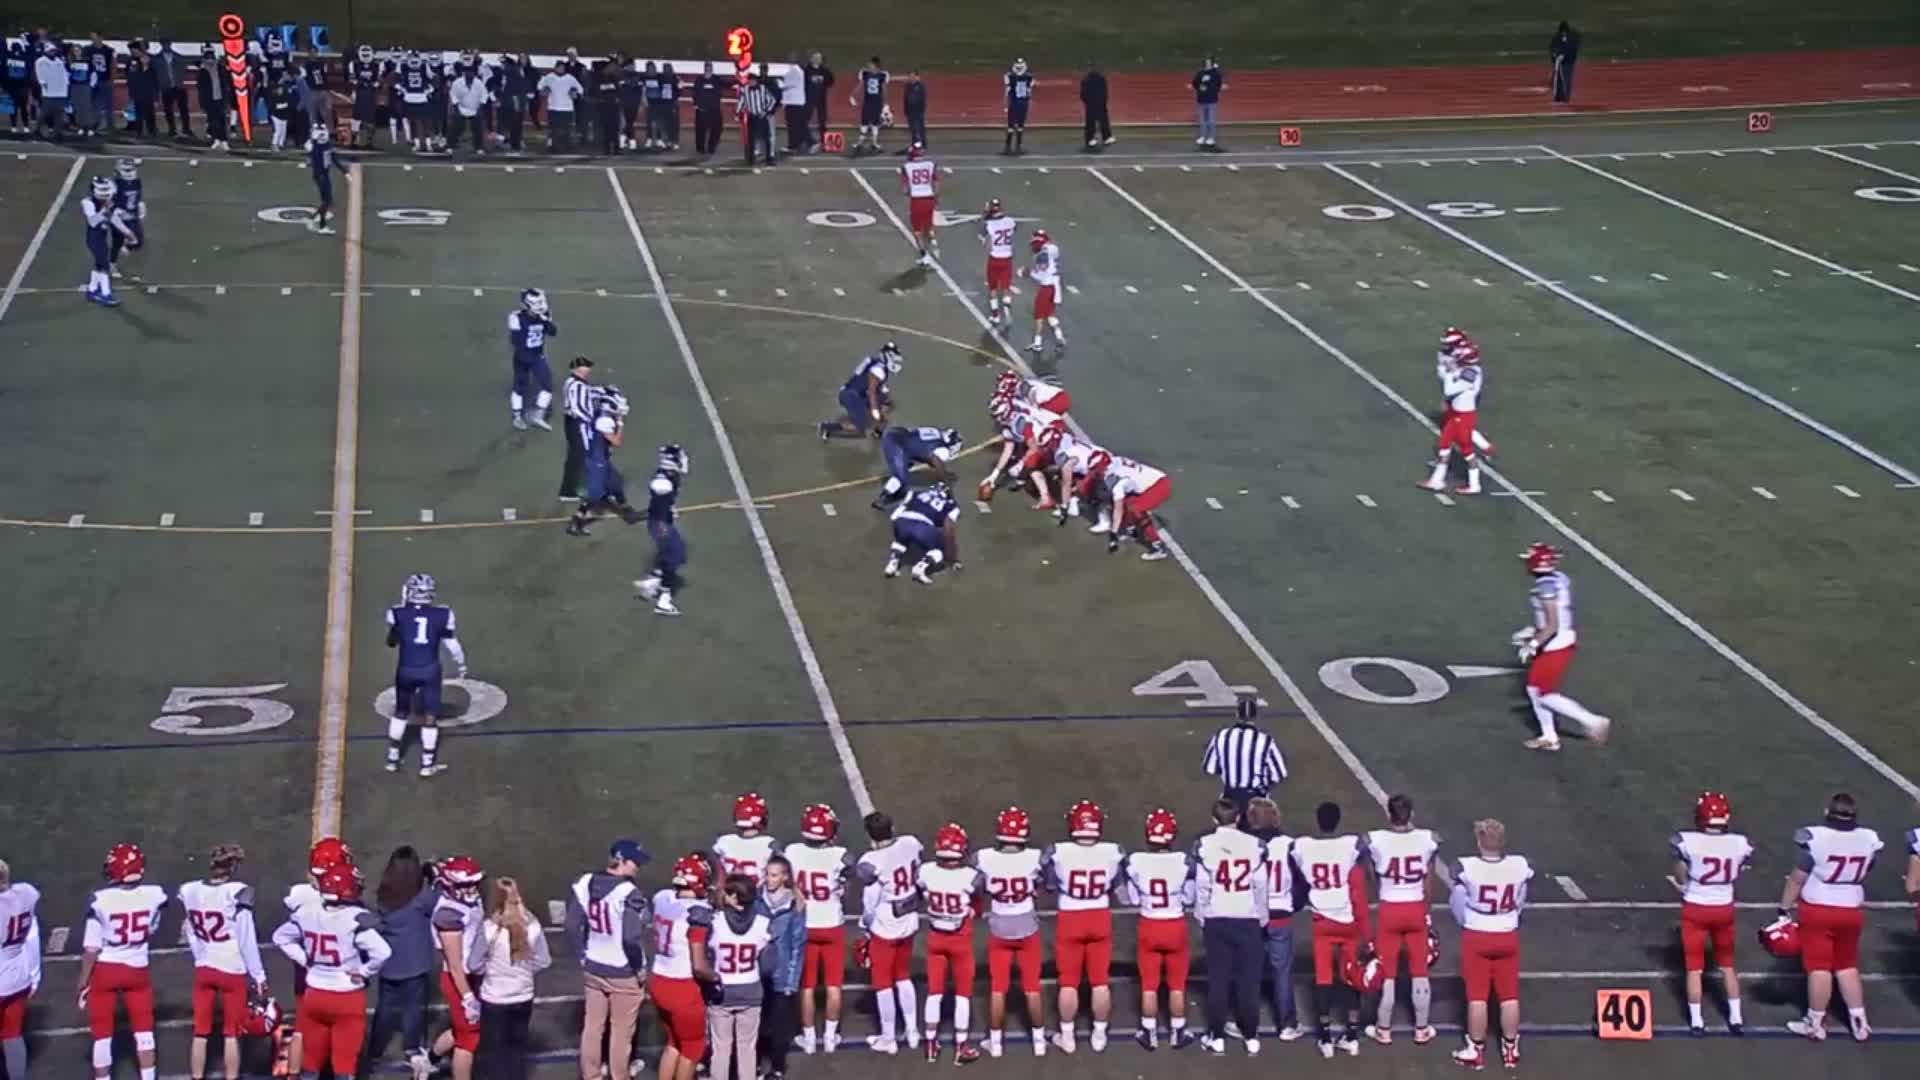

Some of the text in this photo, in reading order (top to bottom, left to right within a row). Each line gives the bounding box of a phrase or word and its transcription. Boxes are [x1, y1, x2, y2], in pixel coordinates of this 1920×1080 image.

[728, 33, 742, 55] 2
[1751, 114, 1769, 128] 20
[911, 168, 930, 185] 89
[413, 616, 430, 645] 1
[1068, 869, 1106, 900] 66
[1215, 858, 1251, 892] 42
[1311, 863, 1341, 890] 81
[1384, 855, 1424, 883] 45
[1699, 857, 1733, 885] 21
[1825, 855, 1868, 884] 77
[796, 871, 830, 902] 46
[990, 876, 1028, 904] 28
[1149, 878, 1169, 909] 9
[1478, 884, 1516, 916] 54
[108, 910, 151, 946] 35
[188, 909, 231, 943] 82
[586, 899, 613, 935] 91
[304, 933, 341, 968] 75
[718, 942, 757, 974] 39
[1601, 993, 1647, 1033] 40
